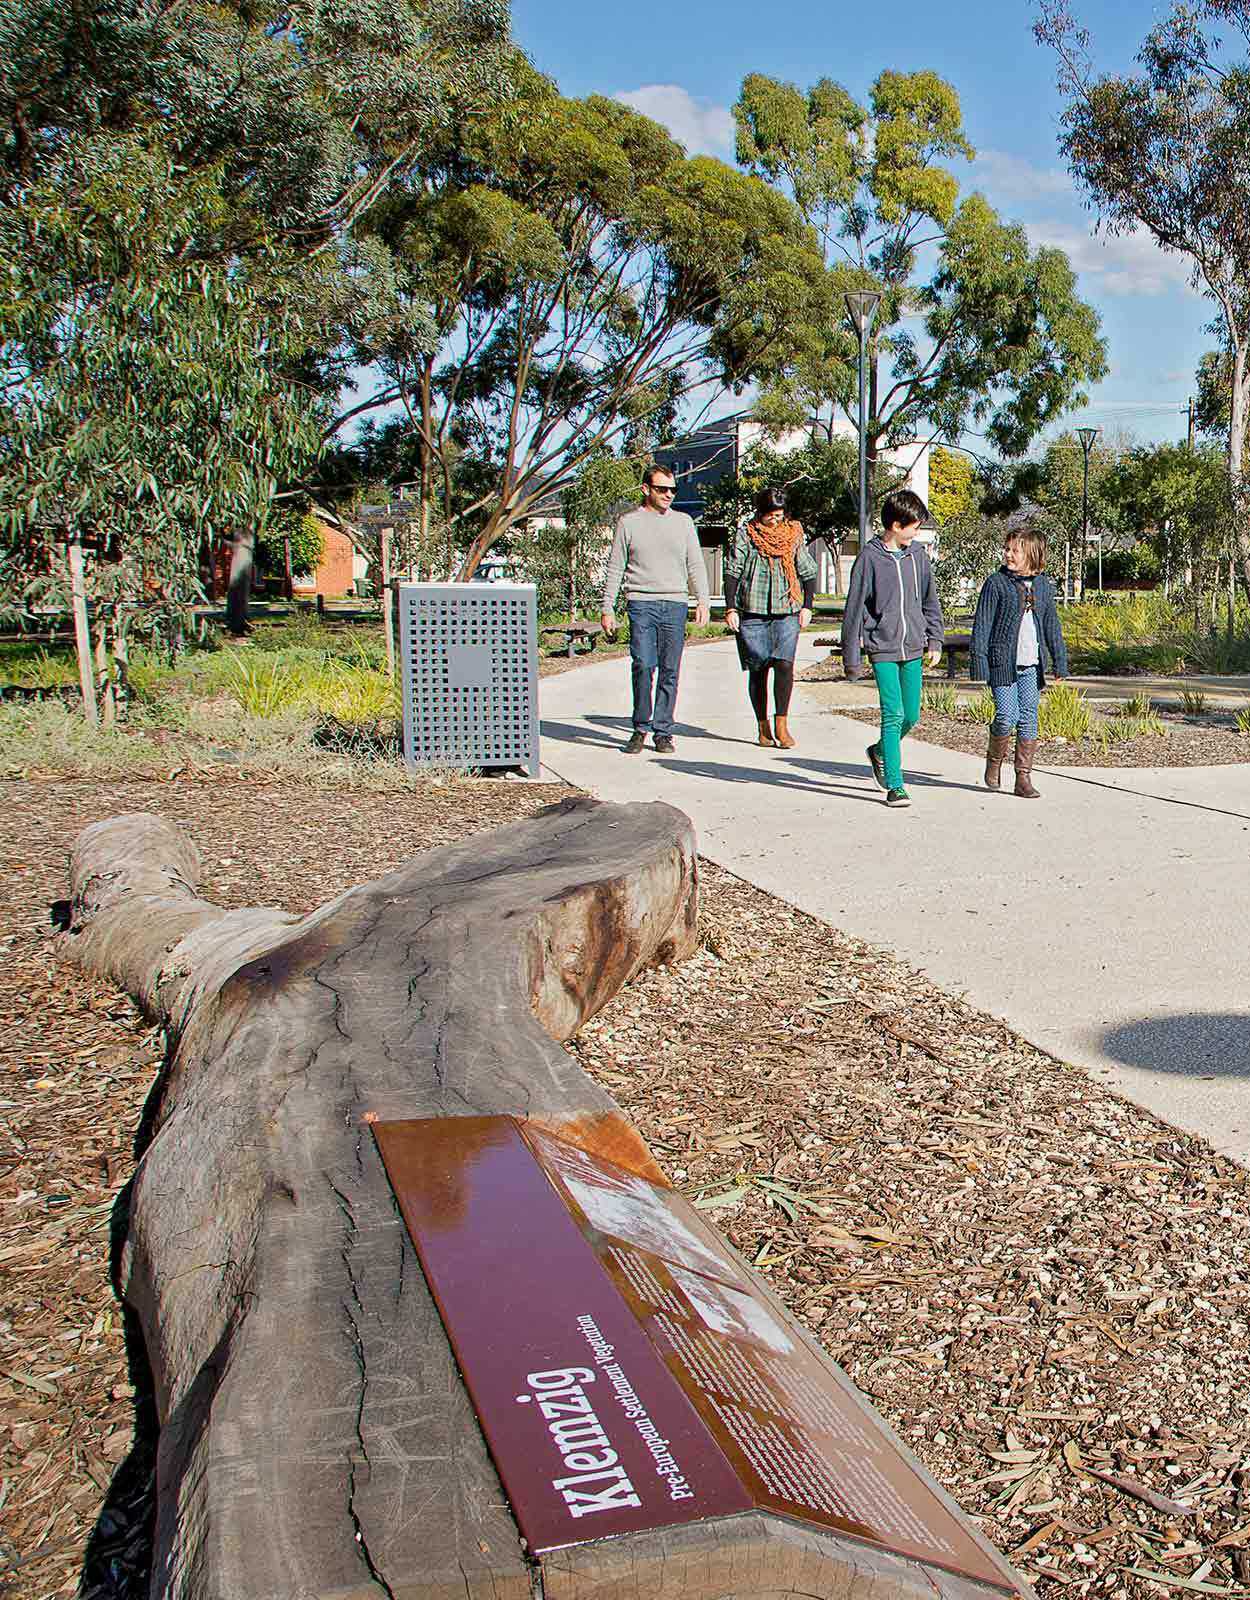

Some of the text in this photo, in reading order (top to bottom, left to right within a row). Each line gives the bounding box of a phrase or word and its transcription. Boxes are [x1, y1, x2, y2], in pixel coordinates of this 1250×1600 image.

[516, 1367, 642, 1518] Klemzig
[576, 1314, 694, 1500] Pre-European Settlement Vegetation
